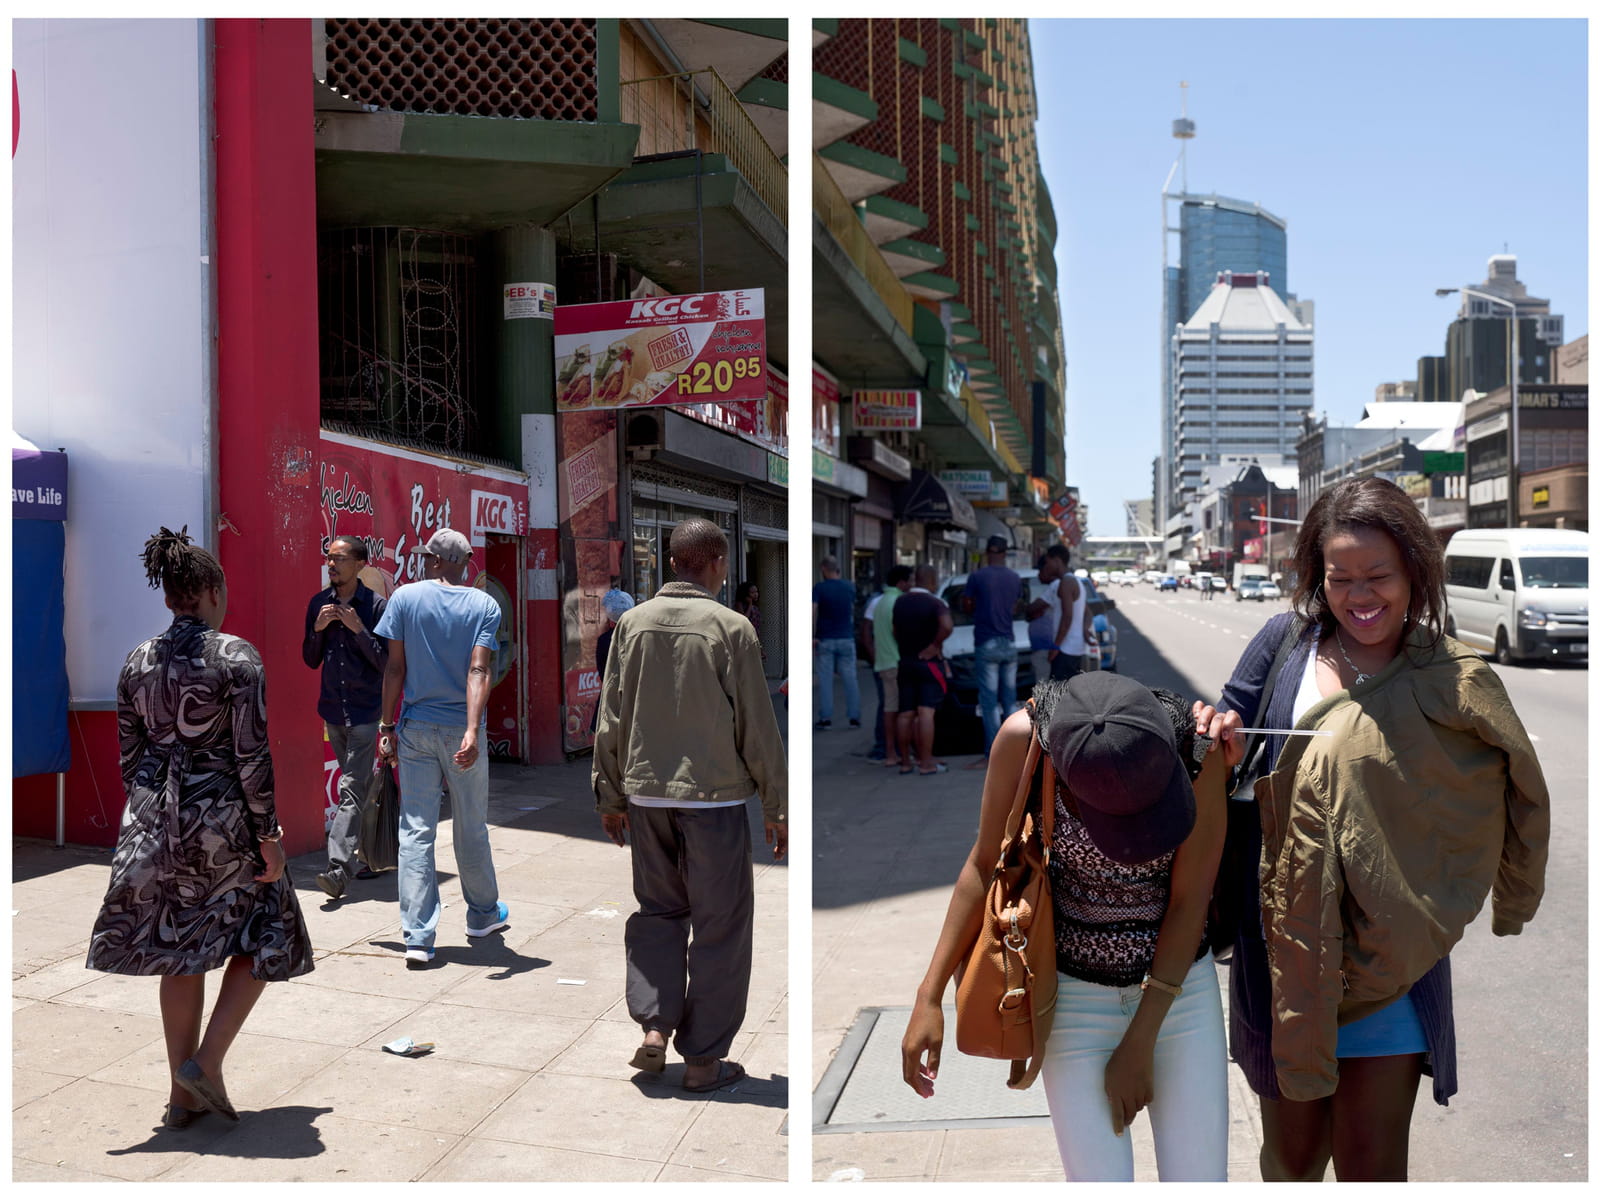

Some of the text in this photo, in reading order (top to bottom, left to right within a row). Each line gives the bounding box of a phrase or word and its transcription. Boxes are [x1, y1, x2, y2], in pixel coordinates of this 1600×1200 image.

[630, 295, 704, 319] KGC
[650, 332, 679, 357] FRESH
[655, 343, 691, 369] HEALTHY
[12, 486, 62, 506] ave Life
[321, 461, 374, 517] hicken
[411, 483, 452, 537] Best
[475, 496, 507, 530] KGC
[578, 671, 600, 690] KGC
